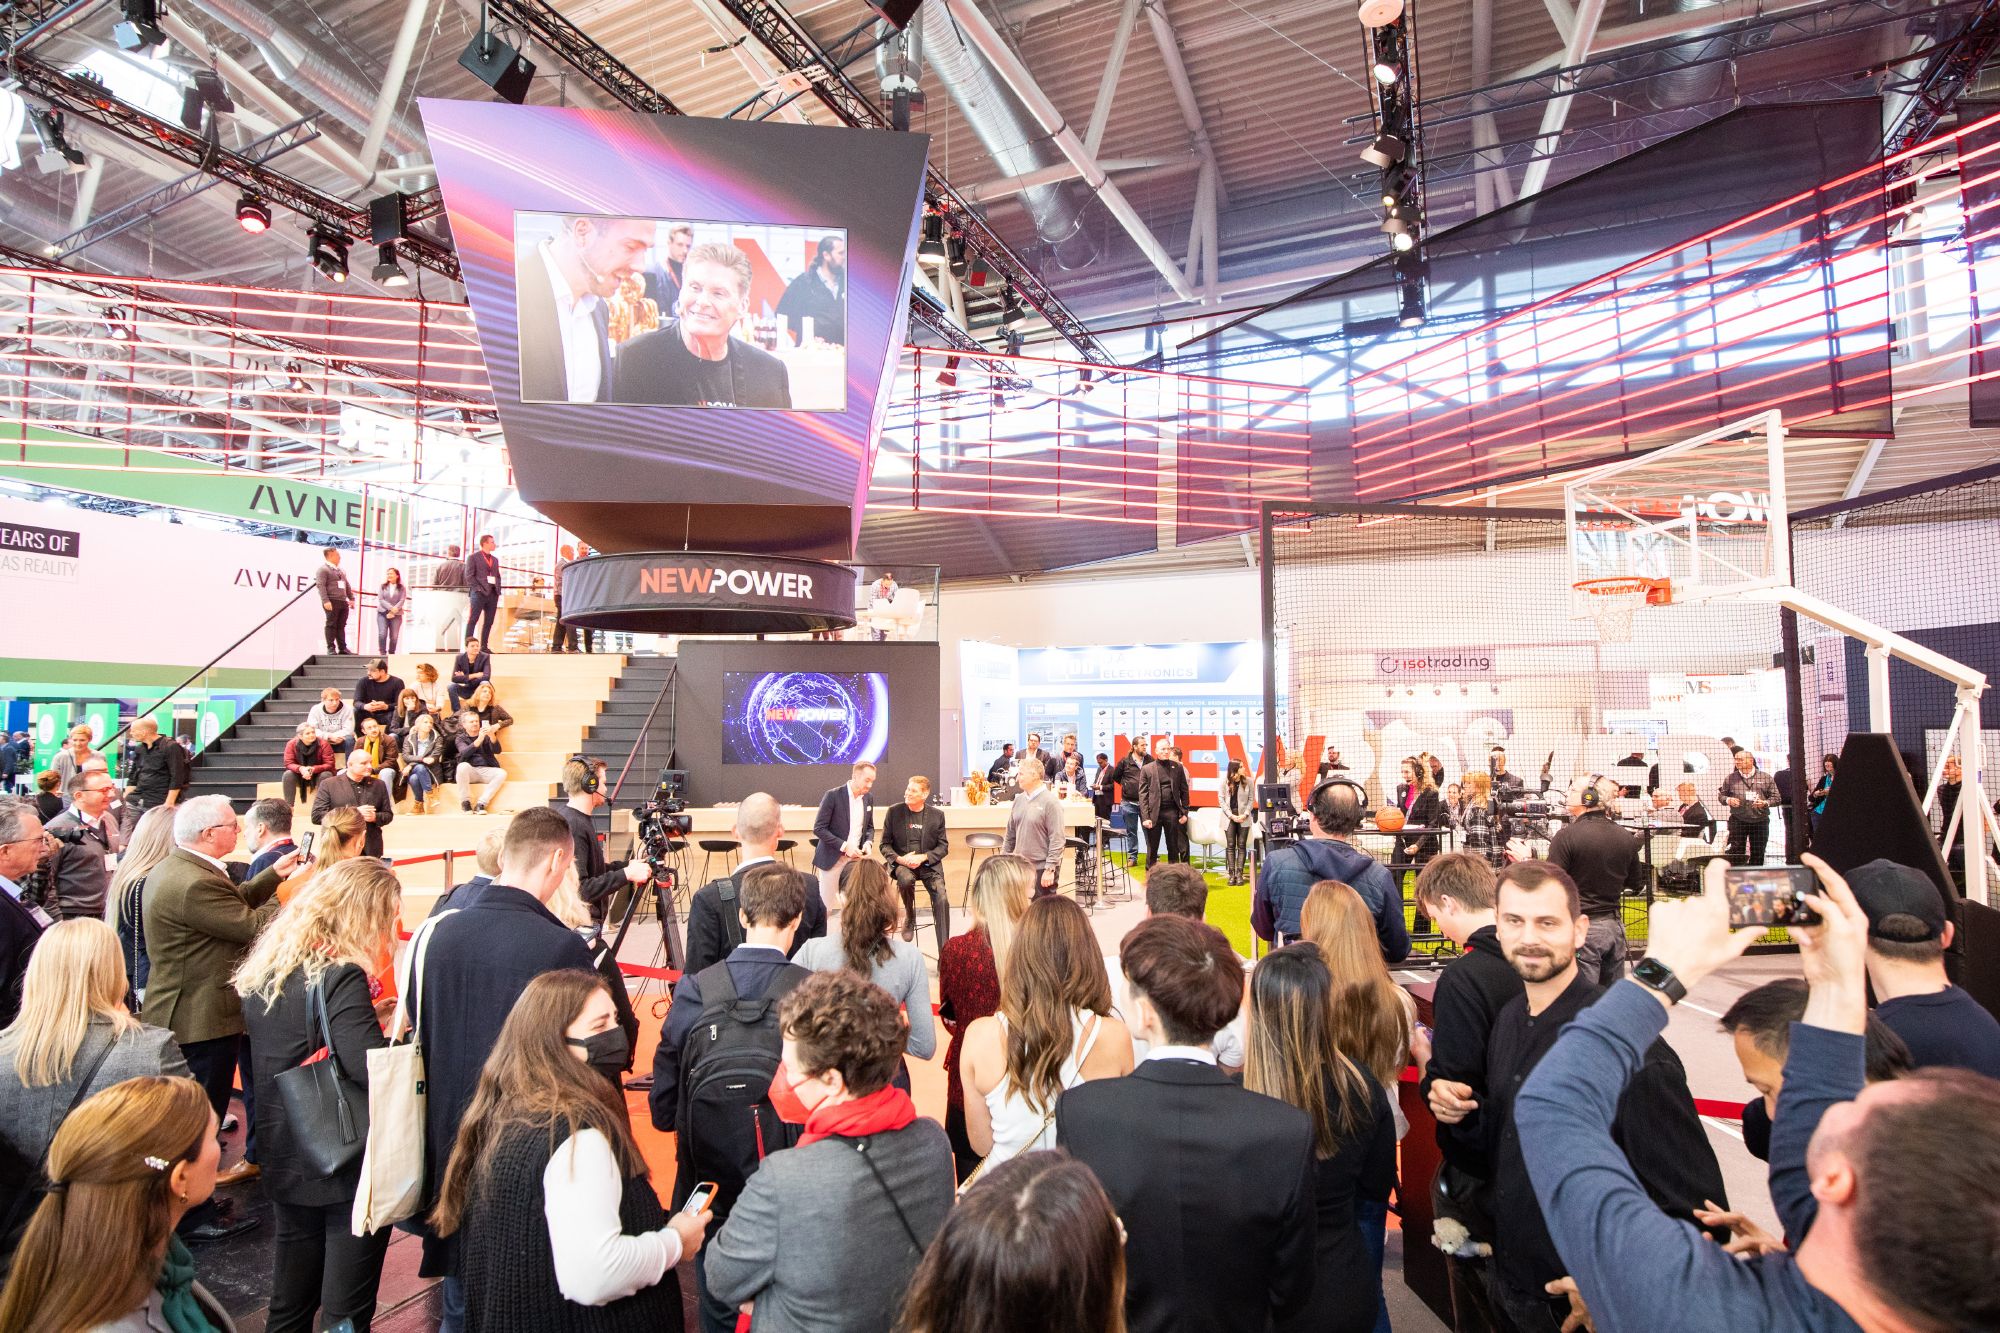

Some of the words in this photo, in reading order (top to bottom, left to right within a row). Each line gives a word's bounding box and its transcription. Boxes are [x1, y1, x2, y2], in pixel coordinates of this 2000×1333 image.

[0, 527, 45, 550] EARS
[48, 534, 72, 552] OF
[0, 554, 21, 572] AS
[23, 557, 78, 577] REALITY
[233, 568, 317, 593] AVNE
[1103, 668, 1195, 679] ELECTRONICS
[1402, 653, 1490, 672] isotrading
